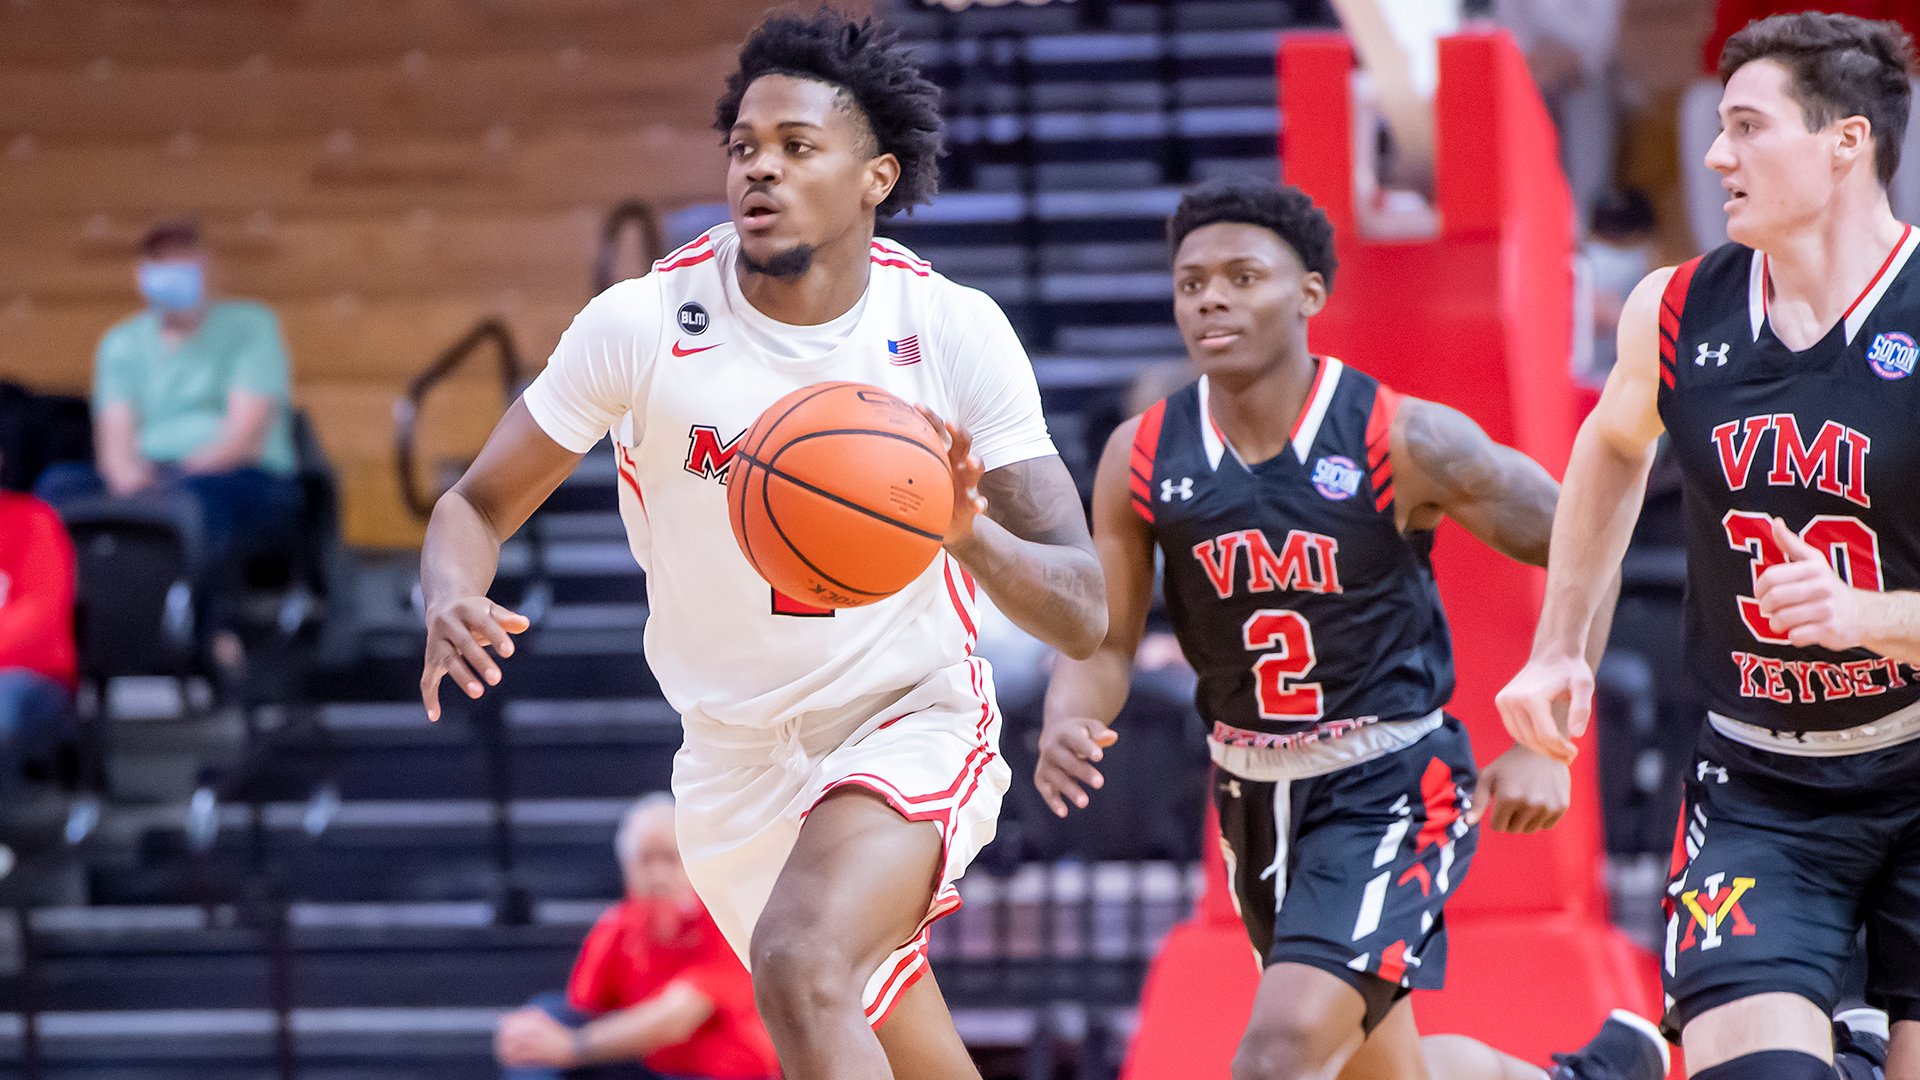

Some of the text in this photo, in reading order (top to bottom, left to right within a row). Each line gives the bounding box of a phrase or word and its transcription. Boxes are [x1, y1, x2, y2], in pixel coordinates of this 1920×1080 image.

[681, 310, 706, 326] BLM
[1868, 334, 1919, 374] SOCON
[1711, 413, 1871, 509] VMI
[1192, 529, 1343, 599] VMI
[1243, 609, 1324, 721] 2
[1731, 651, 1920, 704] KEYDET
